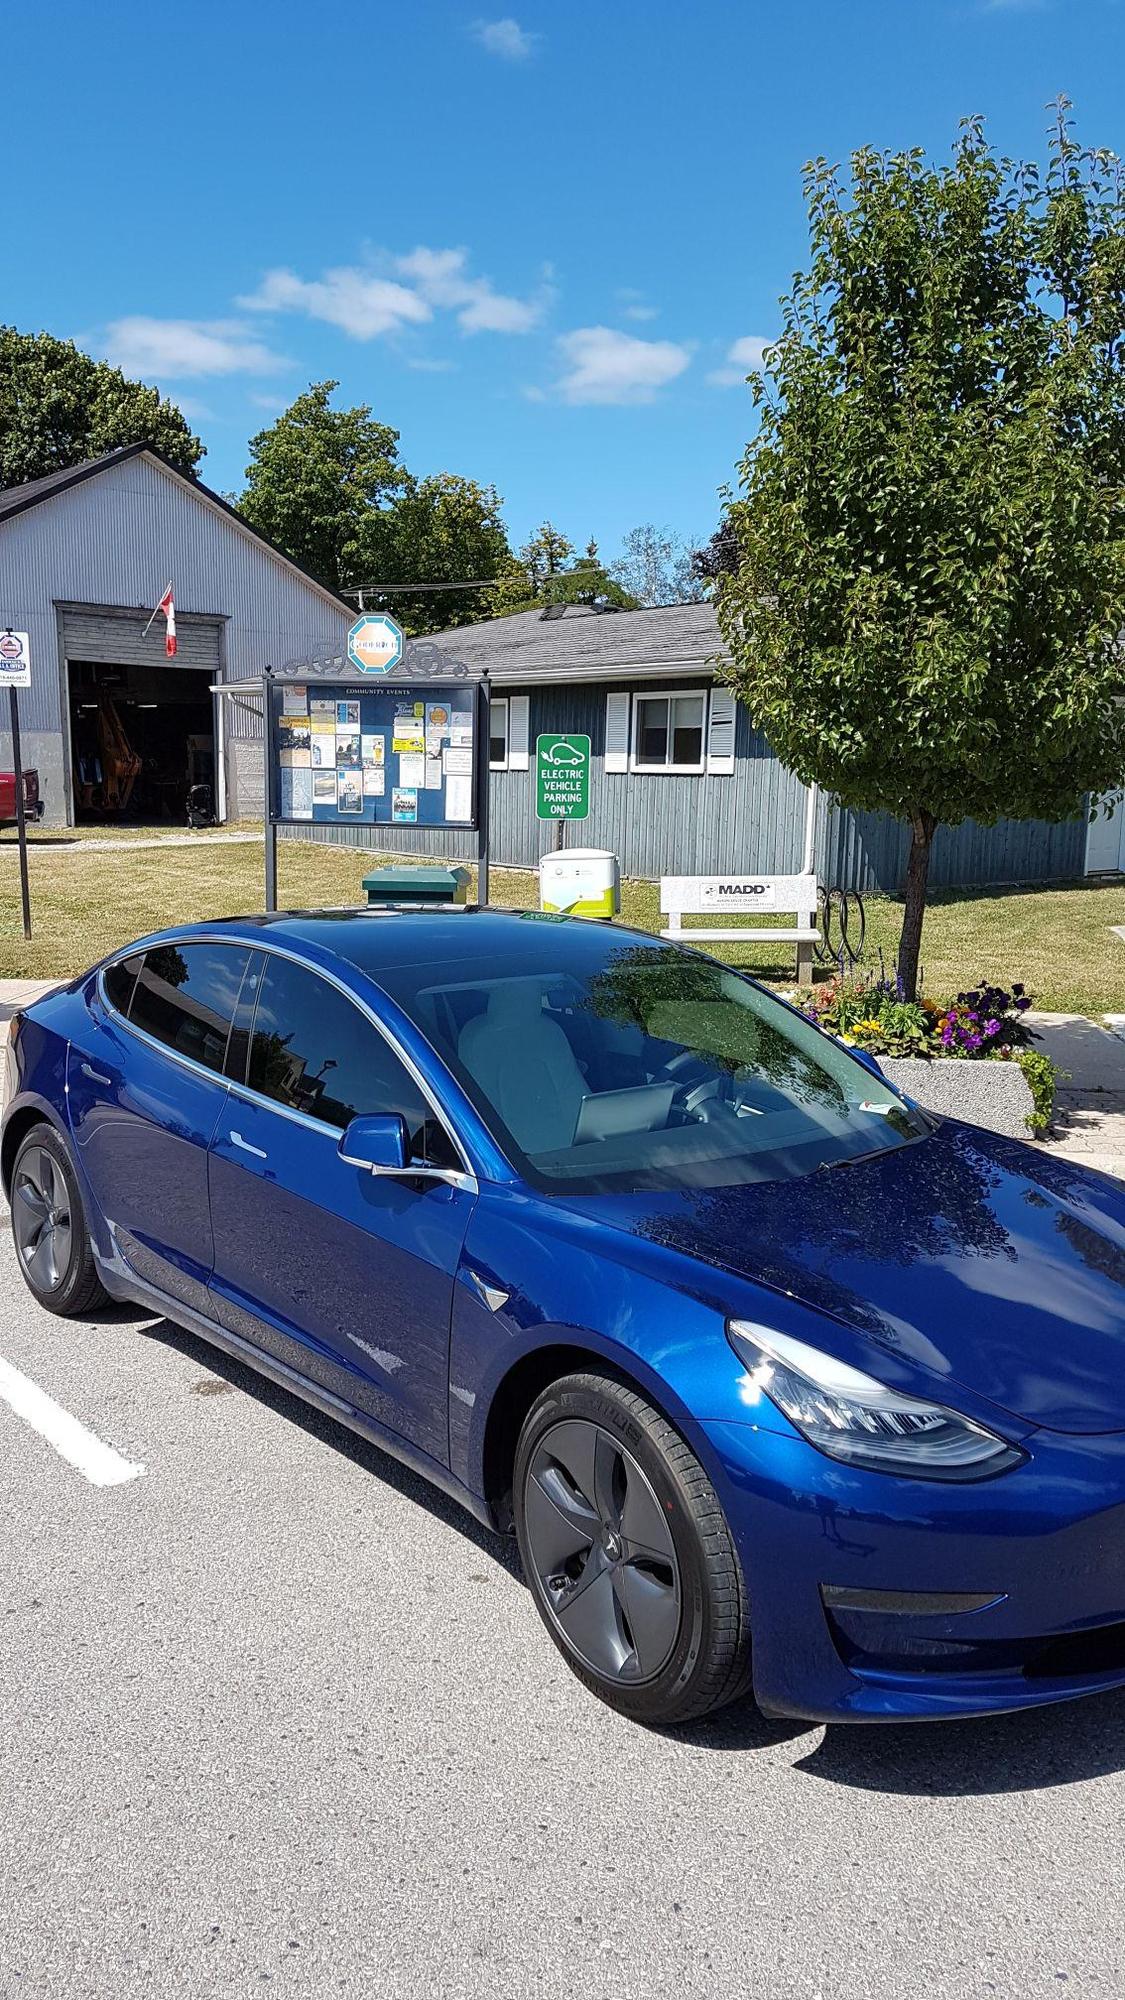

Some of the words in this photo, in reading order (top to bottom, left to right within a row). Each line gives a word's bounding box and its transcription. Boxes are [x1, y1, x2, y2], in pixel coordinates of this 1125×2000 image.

[541, 769, 585, 779] ELECTRIC
[544, 781, 582, 791] VEHICLE
[543, 793, 582, 803] PARKING
[550, 804, 574, 815] ONLY
[718, 885, 766, 895] MADD
